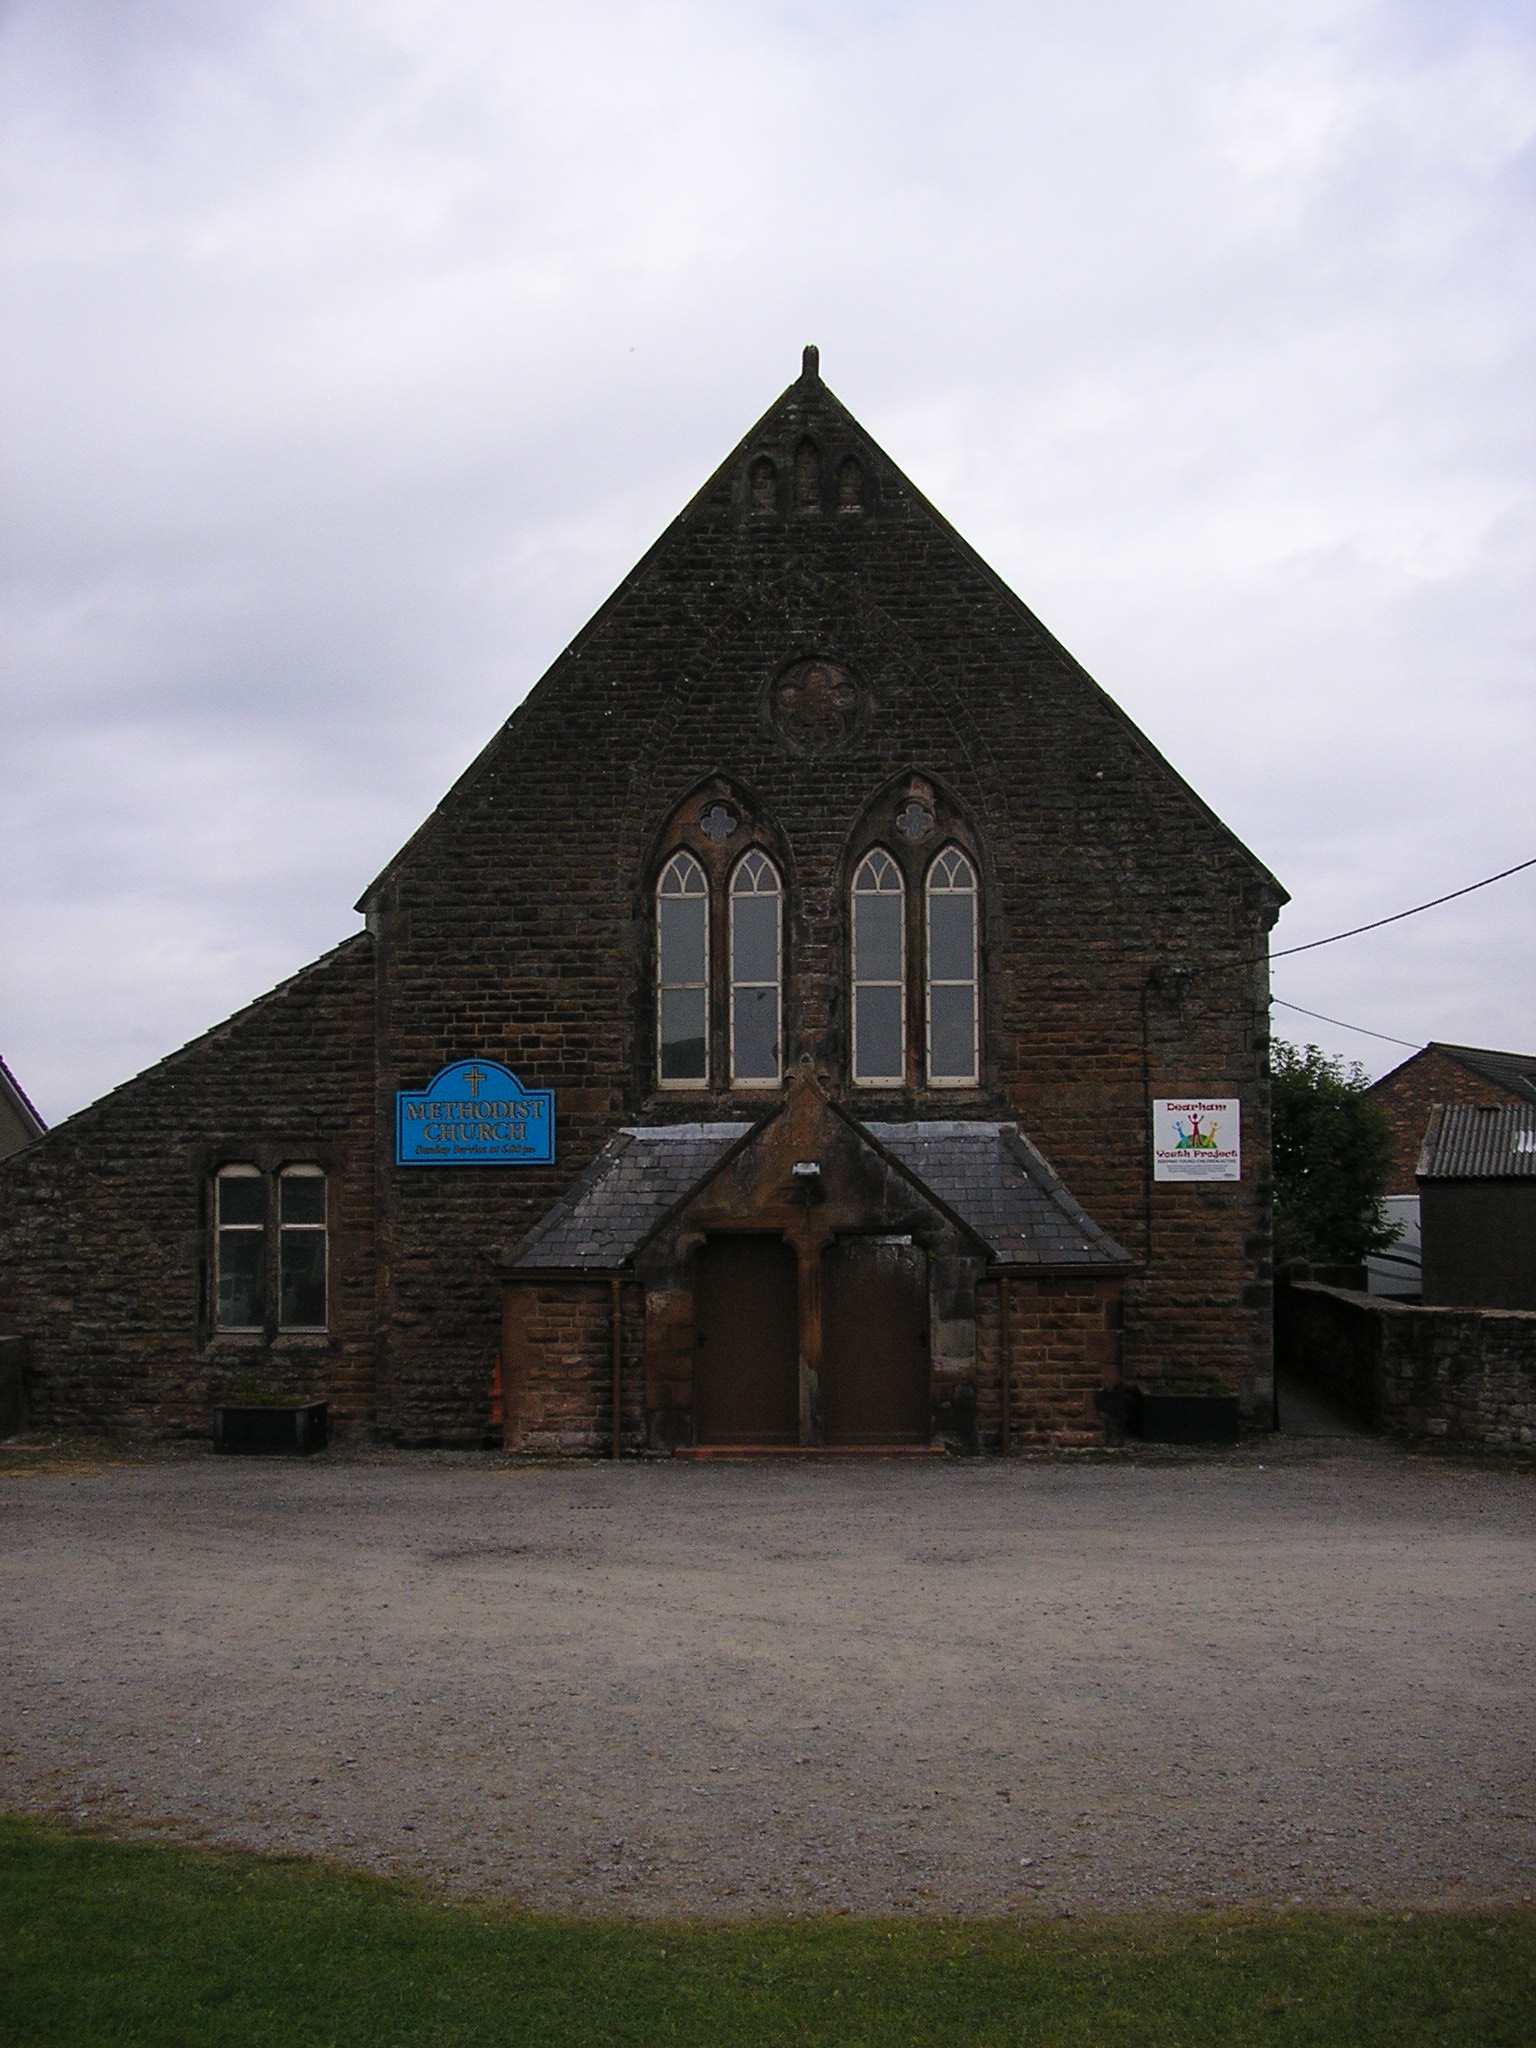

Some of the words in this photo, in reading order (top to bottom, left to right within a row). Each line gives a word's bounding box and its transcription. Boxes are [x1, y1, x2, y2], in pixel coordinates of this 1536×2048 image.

[407, 1100, 544, 1120] METHODIST
[1167, 1102, 1227, 1111] Dearham
[423, 1122, 527, 1141] CHURCH
[1156, 1150, 1190, 1158] Youth
[1194, 1150, 1238, 1158] Project
